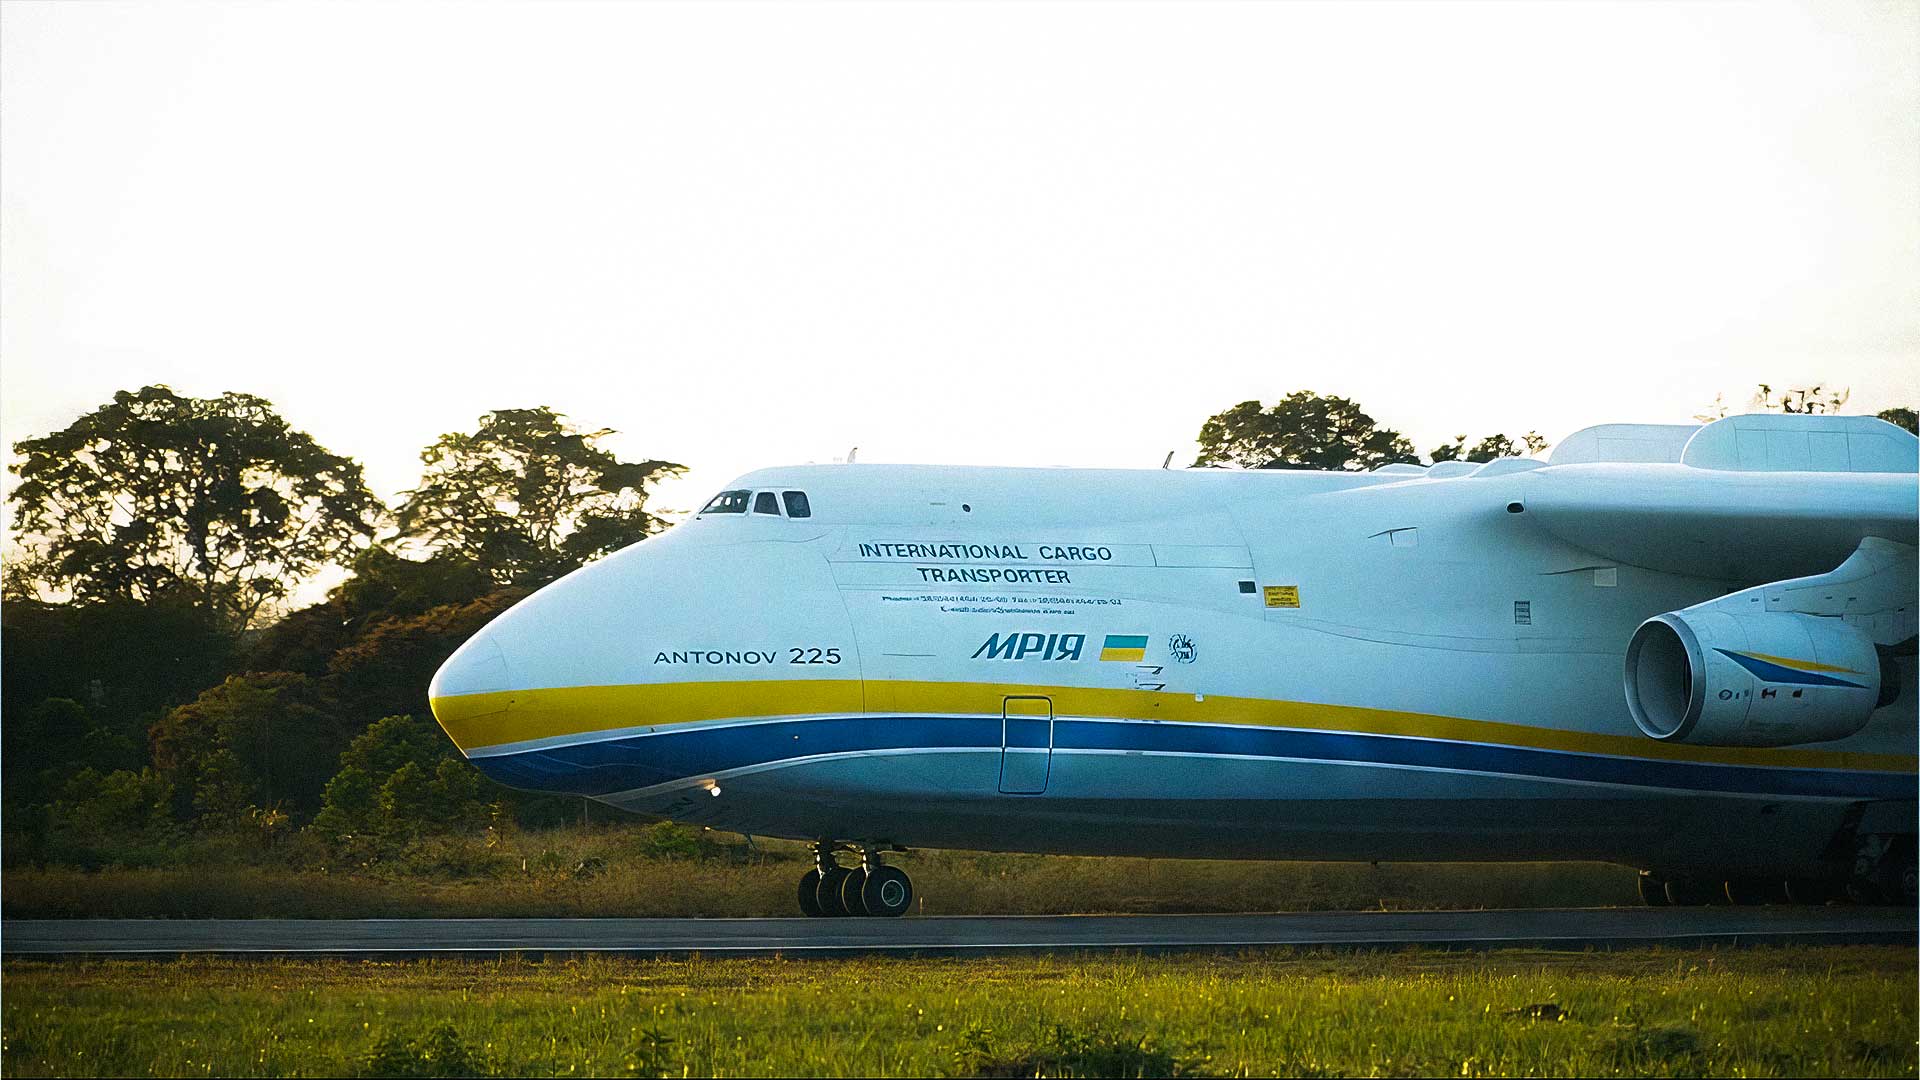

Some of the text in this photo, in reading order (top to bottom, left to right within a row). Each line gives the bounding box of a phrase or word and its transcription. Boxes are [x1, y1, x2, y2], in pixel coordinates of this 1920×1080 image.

[859, 543, 1112, 561] INTERNATIONAL CARGO
[917, 568, 1071, 583] TRANSPORTER
[654, 647, 841, 664] ANTONOV 225
[971, 633, 1085, 661] МРІЯ
